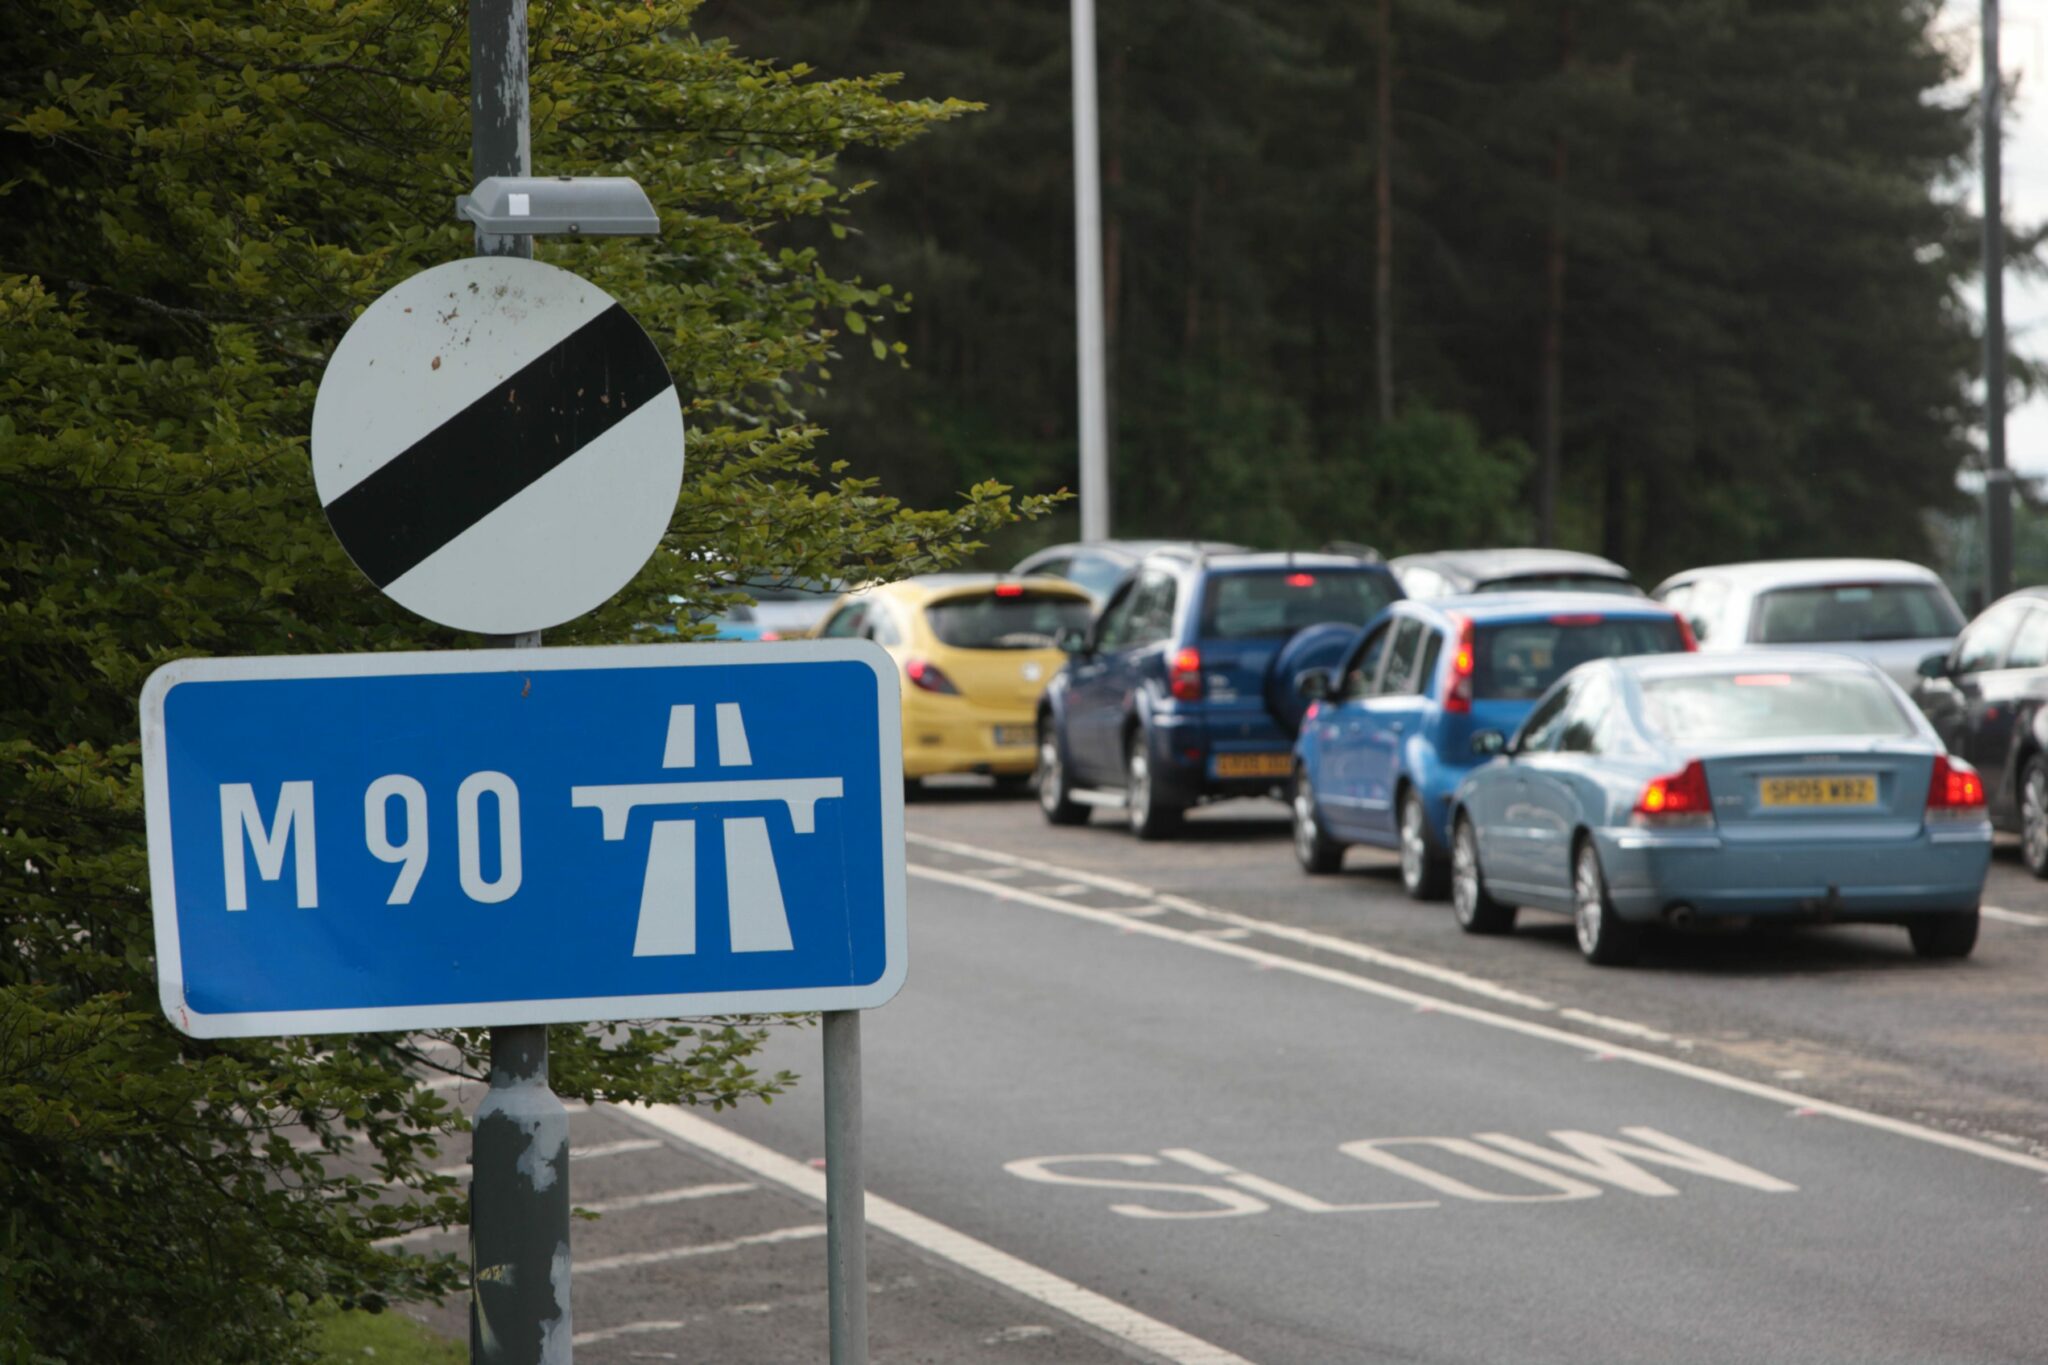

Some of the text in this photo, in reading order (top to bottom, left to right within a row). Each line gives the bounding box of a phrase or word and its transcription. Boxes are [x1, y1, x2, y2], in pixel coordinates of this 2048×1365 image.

[219, 770, 522, 911] M 90
[1003, 1126, 1799, 1219] SLOW
